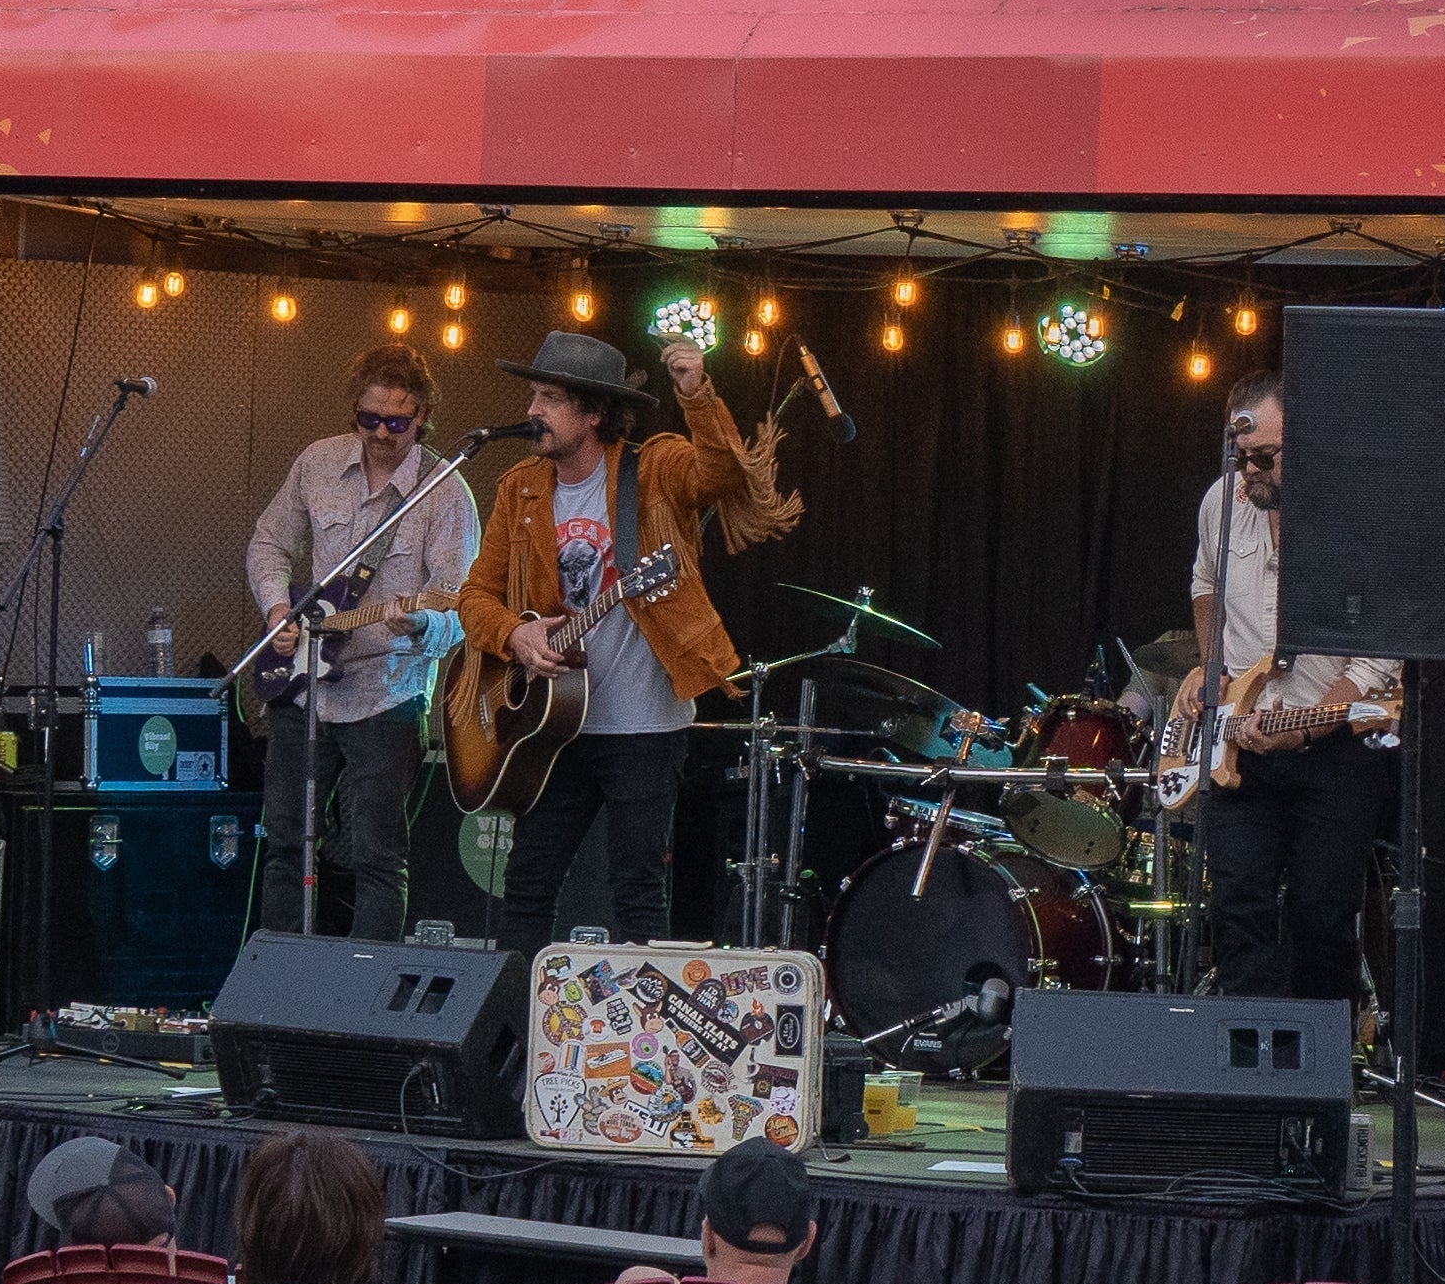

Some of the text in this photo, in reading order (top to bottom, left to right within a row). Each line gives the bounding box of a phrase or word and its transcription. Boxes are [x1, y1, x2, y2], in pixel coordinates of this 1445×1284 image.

[720, 966, 771, 997] LOVE
[696, 993, 716, 1010] THAT
[667, 1005, 729, 1052] IS WHERE IT'S AT
[668, 993, 704, 1026] CANAL
[704, 1019, 739, 1050] FLATS
[541, 1076, 580, 1089] TREE PICKS
